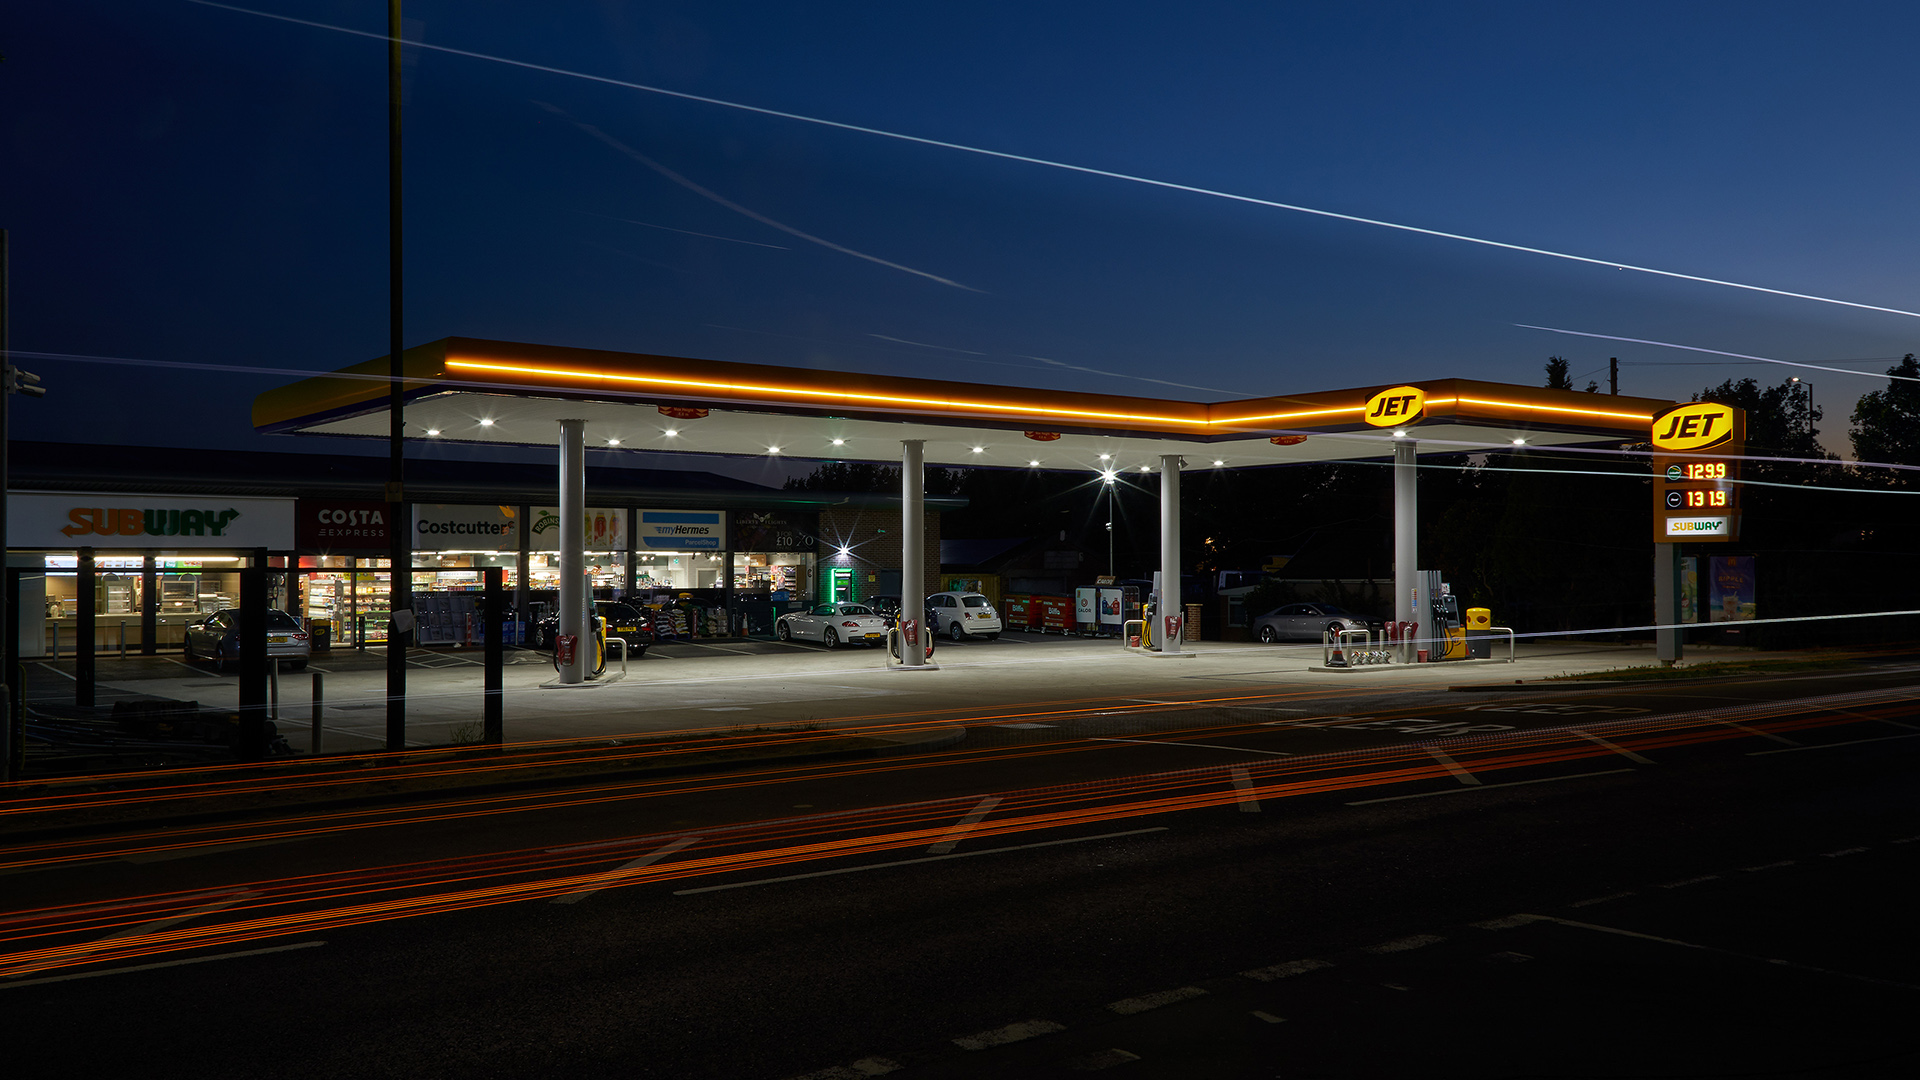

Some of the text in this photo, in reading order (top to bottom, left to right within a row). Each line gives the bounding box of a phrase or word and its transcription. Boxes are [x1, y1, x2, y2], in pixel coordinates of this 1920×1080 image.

[1370, 395, 1417, 417] JET
[1659, 413, 1725, 439] JET
[1688, 463, 1726, 479] 129.9
[60, 507, 241, 538] SUBWAY
[318, 509, 384, 527] COSTA
[535, 515, 560, 533] ROBINS
[328, 528, 384, 537] EXPRESS
[416, 519, 507, 535] Costcutter
[661, 525, 709, 535] myHermes
[1671, 521, 1723, 532] SUBWAY
[776, 537, 793, 546] £10
